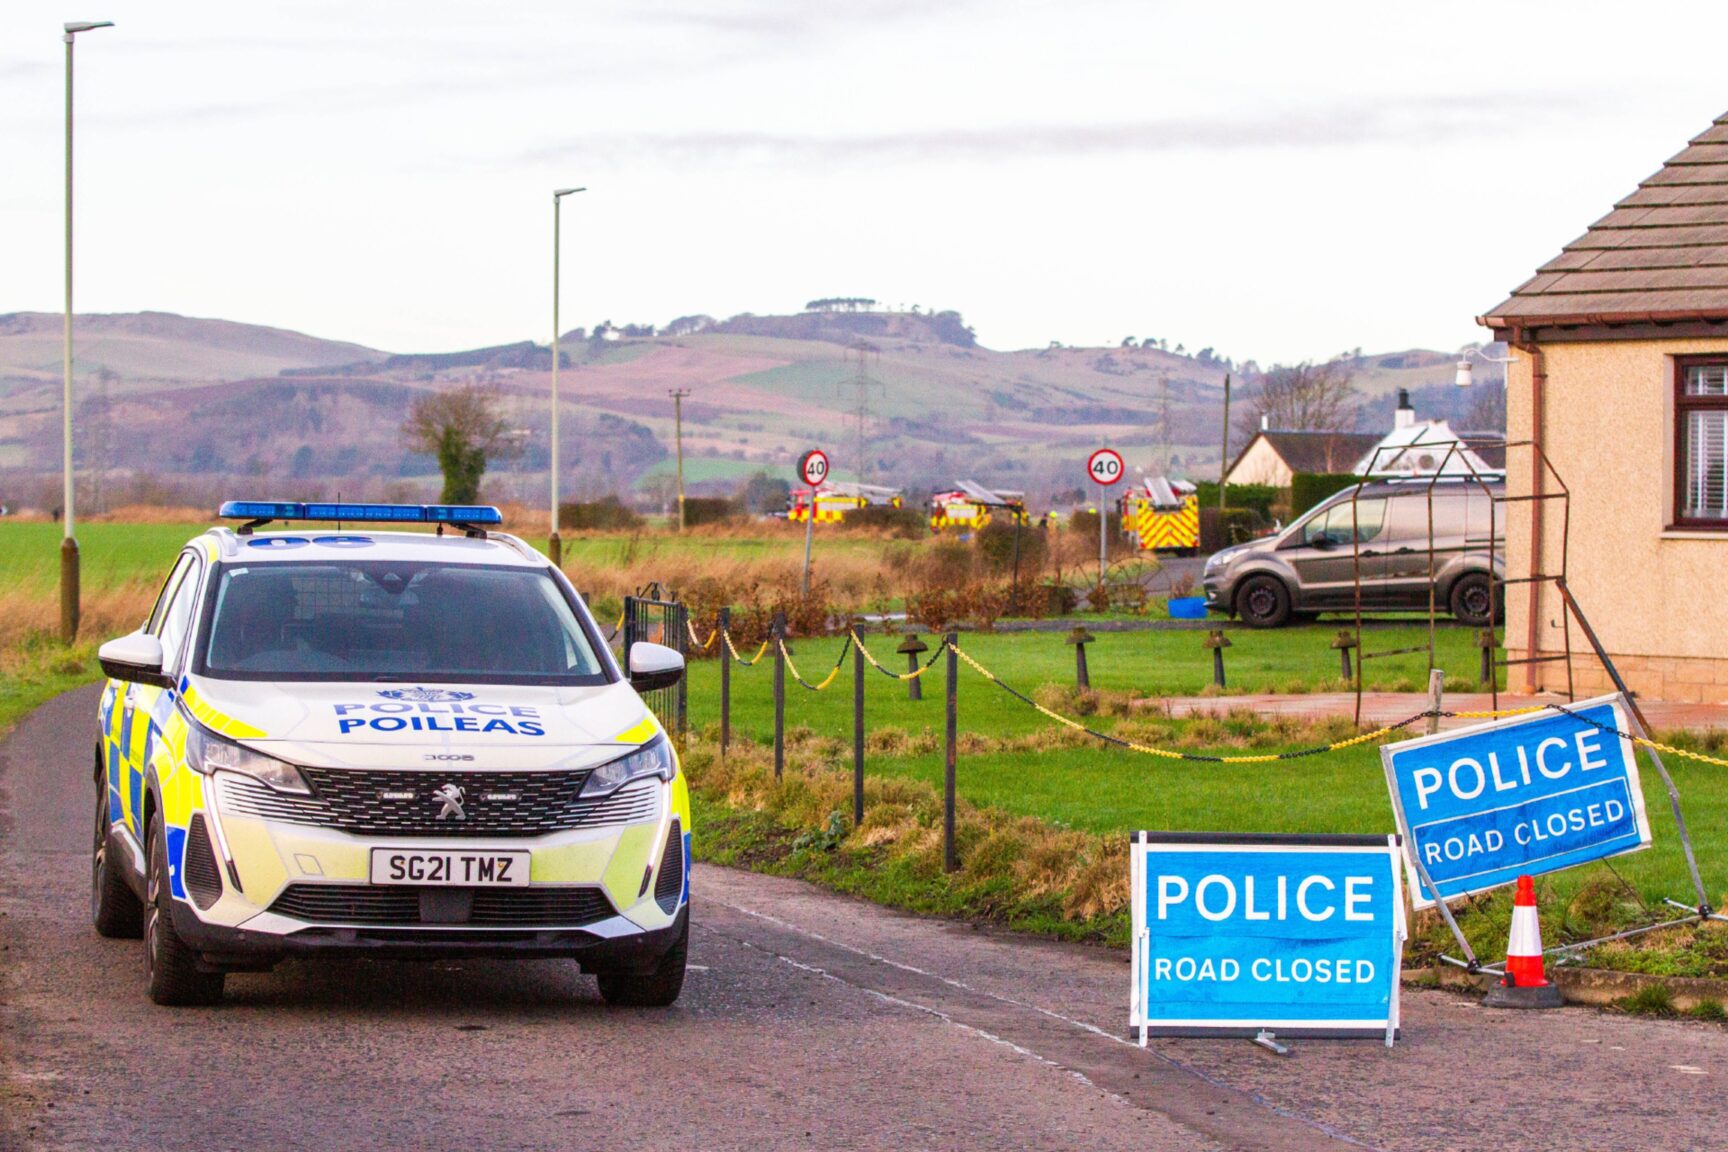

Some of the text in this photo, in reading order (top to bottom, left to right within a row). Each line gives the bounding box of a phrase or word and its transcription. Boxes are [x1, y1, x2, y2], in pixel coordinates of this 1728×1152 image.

[807, 461, 825, 475] 40
[1093, 461, 1119, 475] 40
[333, 702, 540, 718] POLICE
[338, 716, 545, 736] POILEAS
[1413, 728, 1607, 810] POLICE
[1424, 799, 1624, 865] ROAD CLOSED
[390, 855, 513, 882] SG21 TMZ
[1157, 874, 1374, 921] POLICE
[1155, 957, 1375, 983] ROAD CLOSED
